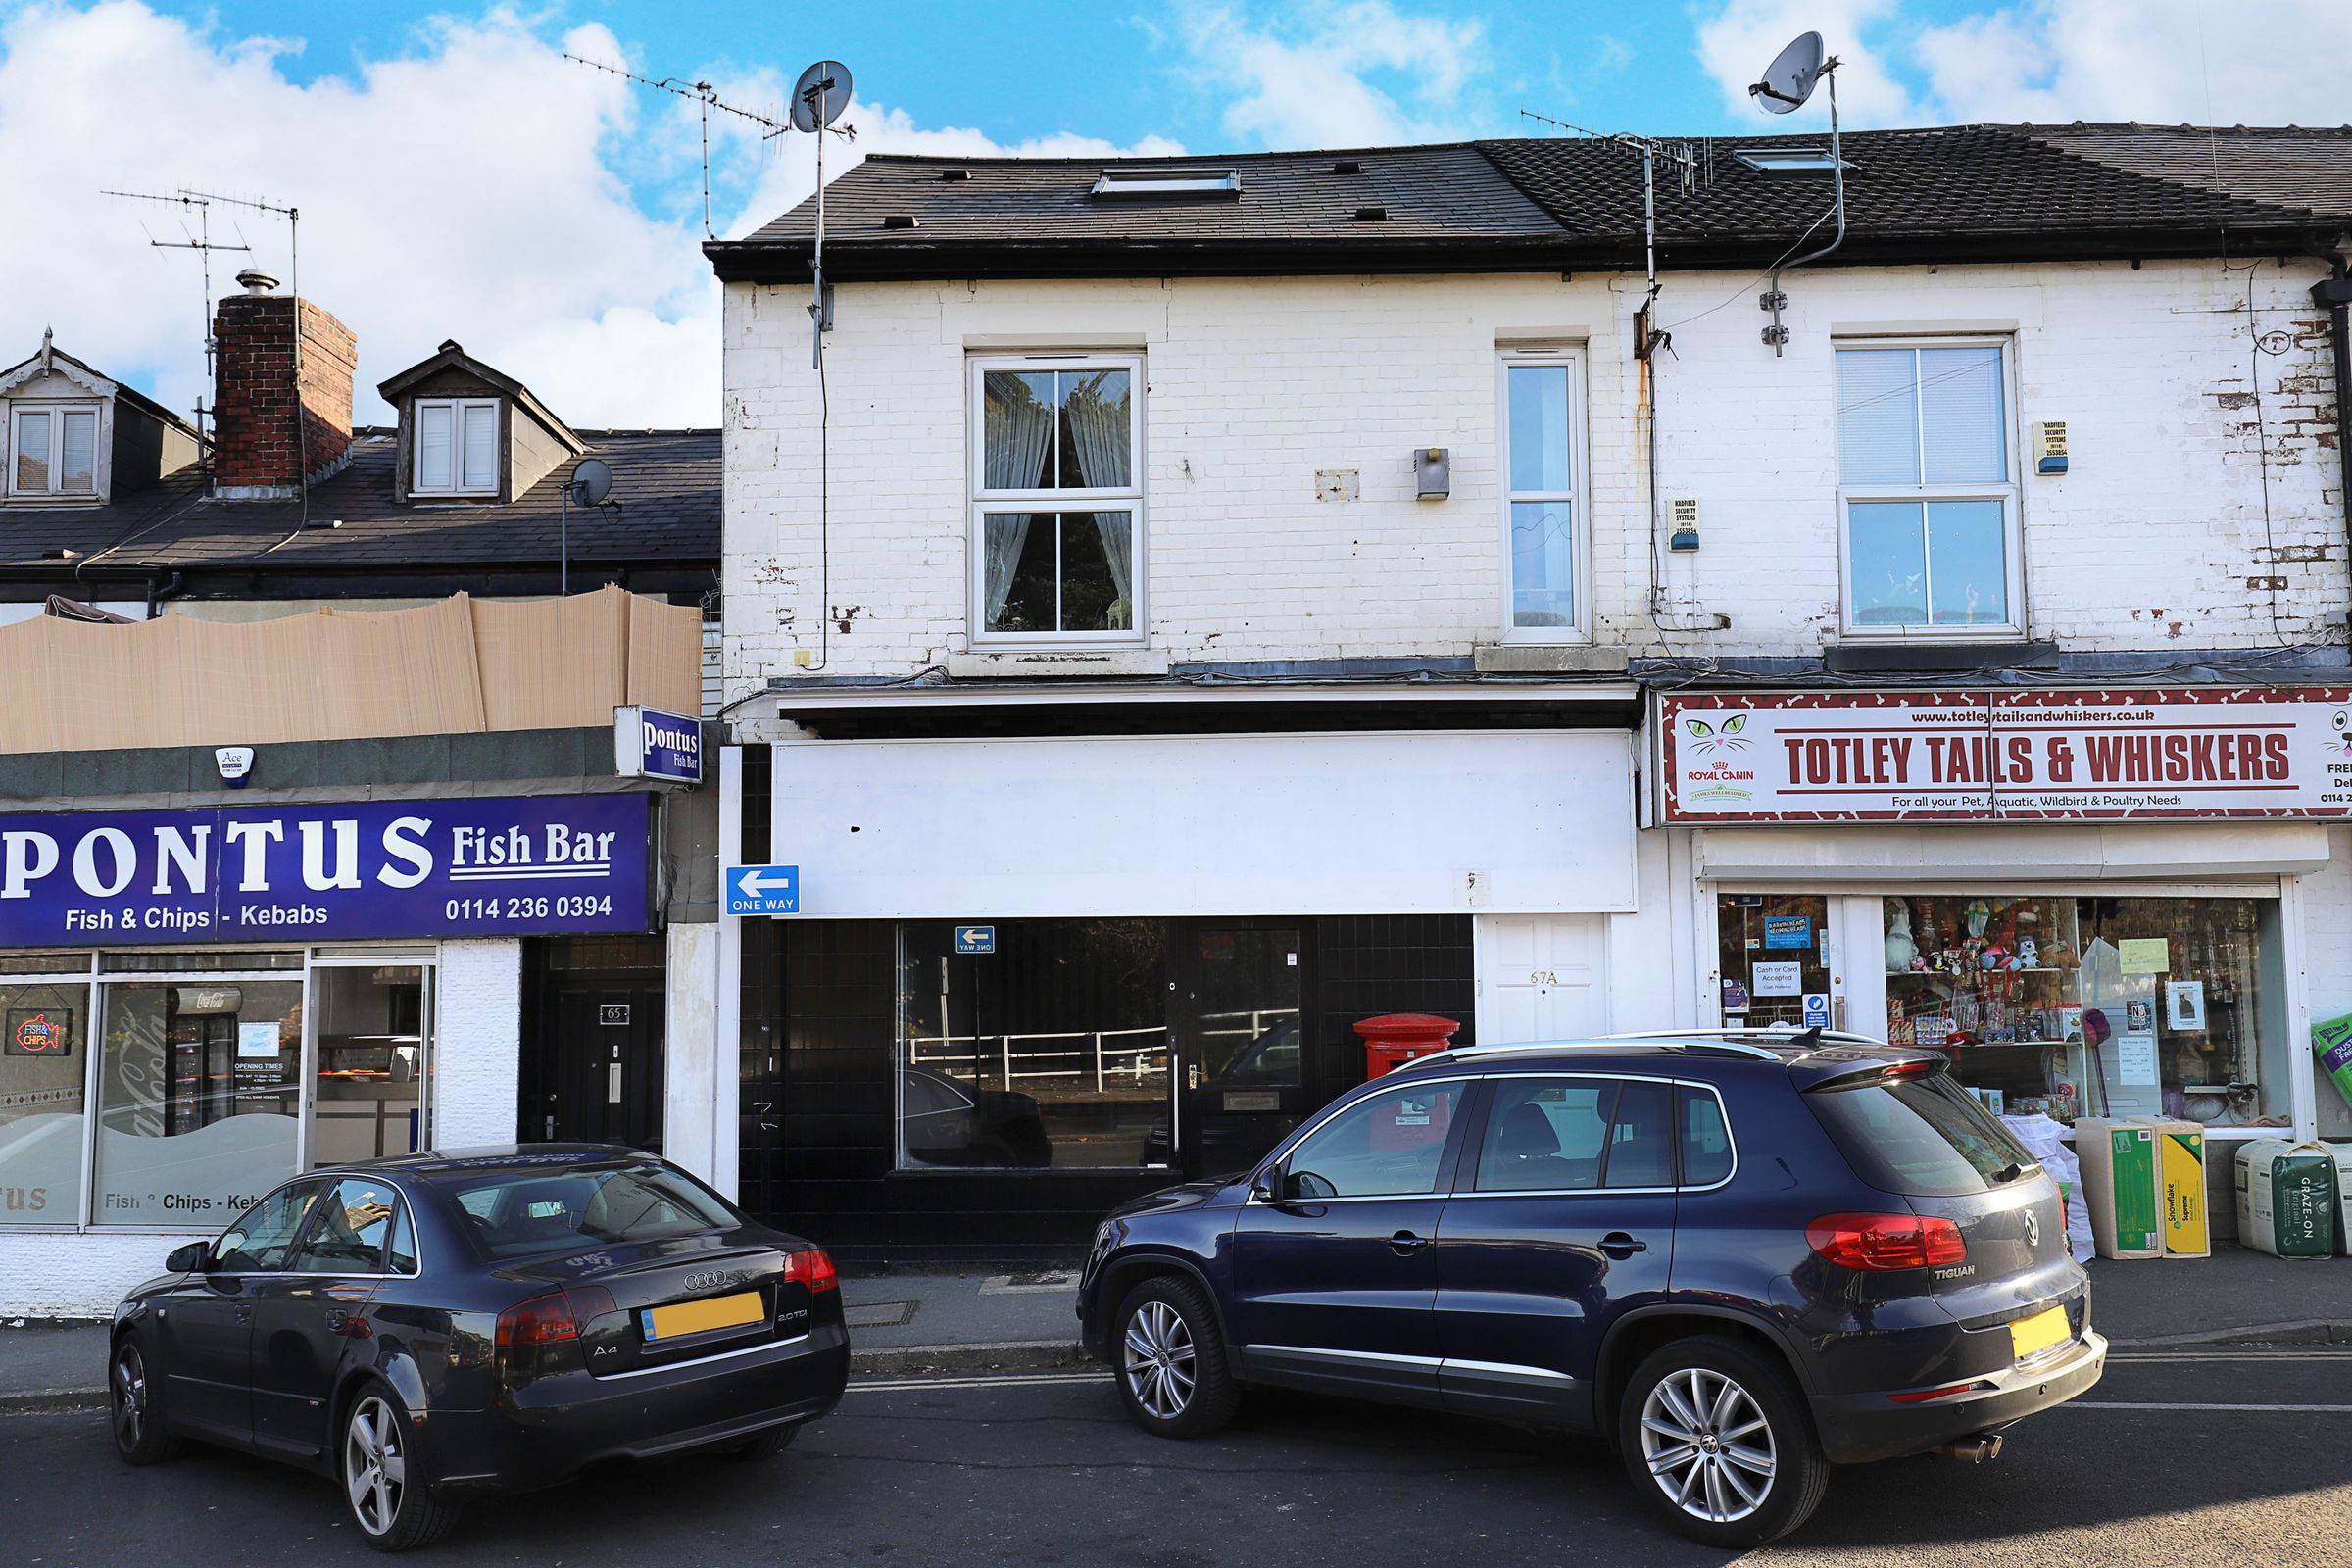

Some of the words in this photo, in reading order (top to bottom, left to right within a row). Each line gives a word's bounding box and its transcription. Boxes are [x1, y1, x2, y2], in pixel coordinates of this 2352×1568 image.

[643, 721, 697, 755] Pontus
[222, 752, 242, 763] Ace
[673, 753, 686, 768] Fish
[687, 755, 698, 769] Bar
[1784, 737, 1911, 784] TOTLEY
[1925, 736, 2033, 783] TAILS
[2047, 737, 2075, 782] &
[2085, 733, 2289, 782] WHISKERS
[1688, 771, 1720, 780] ROYAL
[1721, 771, 1754, 780] CANIN
[1892, 797, 1911, 807] For
[1914, 796, 1928, 807] all
[1932, 797, 1957, 810] your
[1962, 796, 1984, 808] Pet,
[2040, 795, 2087, 807] Wildbird
[2090, 796, 2100, 806] &
[2103, 795, 2144, 808] Poultry
[2147, 794, 2181, 805] Needs
[452, 825, 532, 865] Fish
[545, 824, 615, 862] Bar
[1, 816, 433, 899] PONTUS
[446, 899, 499, 920] 0114
[506, 897, 548, 918] 236
[556, 896, 612, 916] 0394
[733, 900, 760, 911] ONE
[765, 899, 794, 910] WAY
[65, 908, 114, 930] Fish
[121, 908, 137, 928] &
[144, 906, 210, 932] Chips
[240, 904, 327, 925] Kebabs
[1530, 971, 1558, 984] 67A
[608, 1007, 621, 1019] 65
[24, 1025, 40, 1034] FISH
[40, 1025, 49, 1035] &
[24, 1035, 47, 1045] CHIPS
[163, 1194, 212, 1212] Chips
[2167, 1183, 2176, 1222] Snowflake
[2301, 1177, 2314, 1239] GRAZE-ON
[1935, 1265, 1976, 1280] TIGUAN
[593, 1346, 618, 1357] A4
